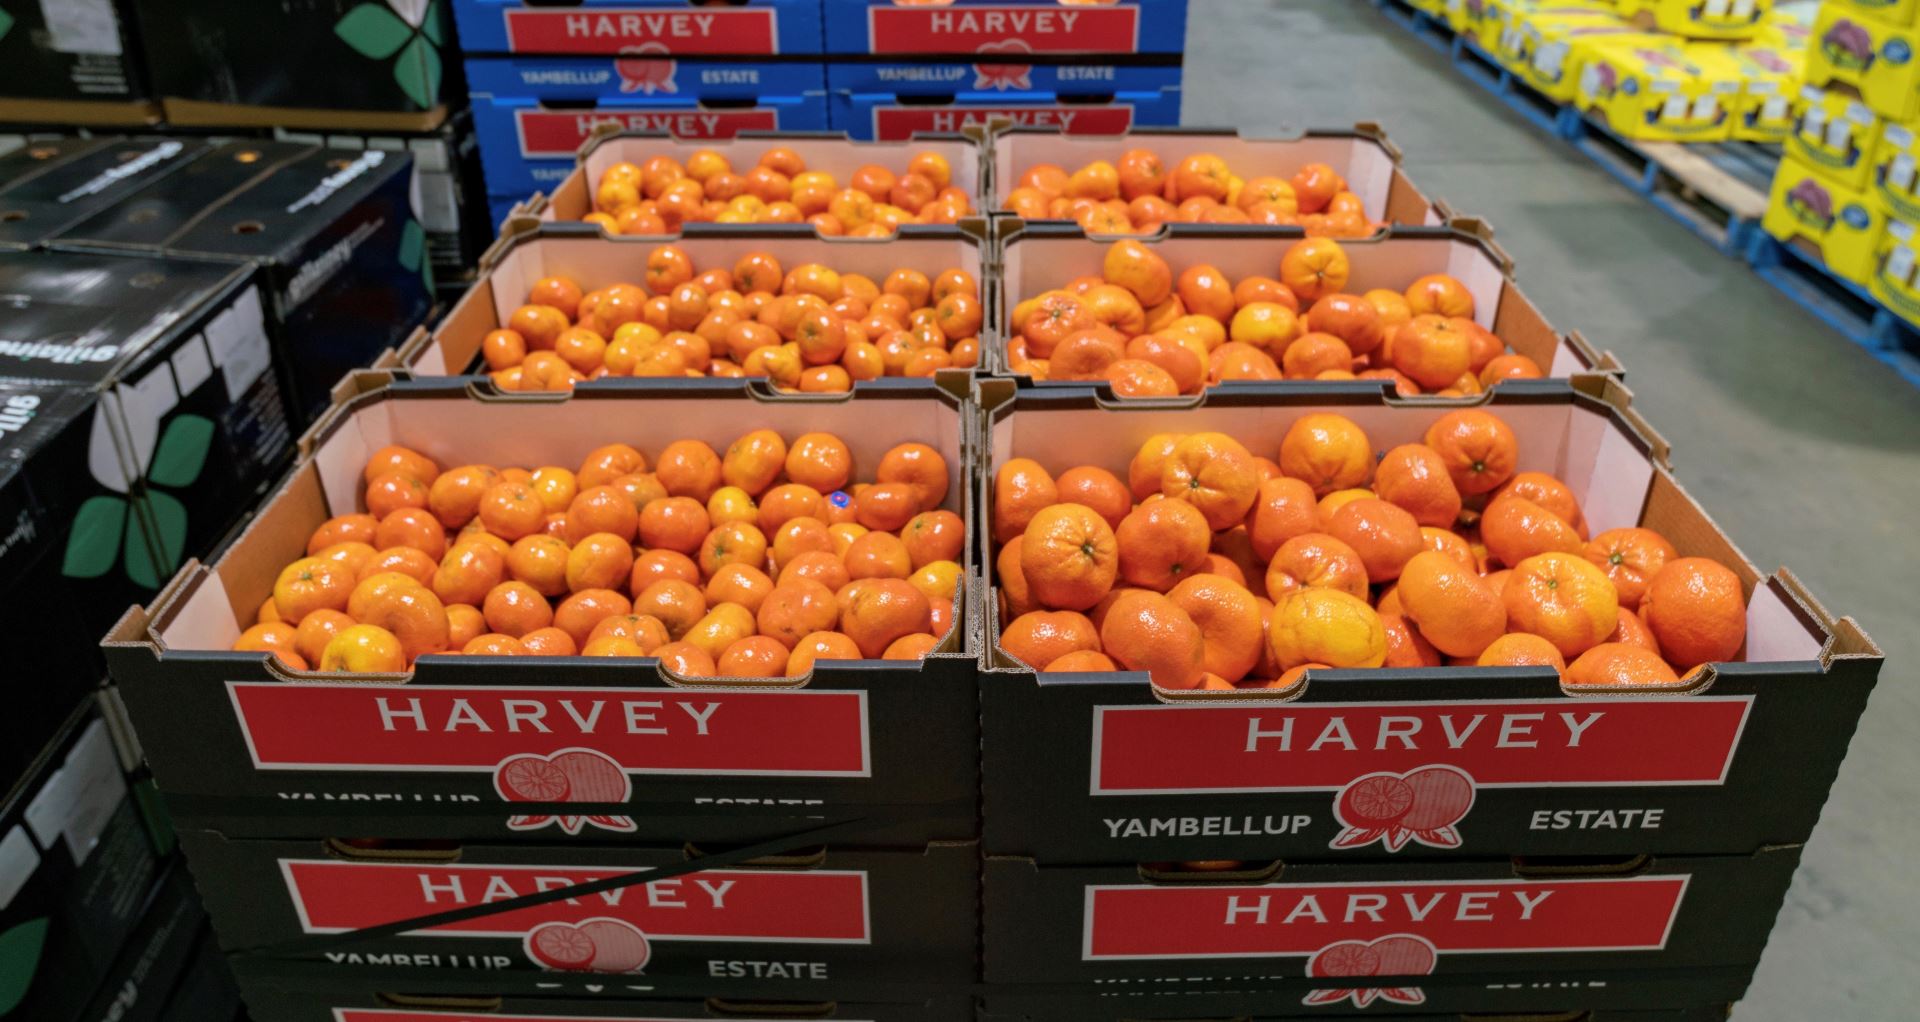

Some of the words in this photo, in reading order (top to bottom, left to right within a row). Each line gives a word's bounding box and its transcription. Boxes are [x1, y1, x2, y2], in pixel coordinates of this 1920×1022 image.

[565, 15, 715, 37] HARVEY
[930, 11, 1079, 34] HARVEY
[520, 71, 611, 85] YAMBELLUP
[701, 70, 760, 85] ESTATE
[876, 67, 966, 81] YAMBELLUP
[1056, 66, 1115, 82] ESTATE
[374, 697, 723, 736] HARVEY
[1243, 712, 1606, 753] HARVEY
[1102, 814, 1313, 839] YAMBELLUP
[1528, 808, 1665, 831] ESTATE
[1223, 890, 1555, 926] HARVEY
[707, 959, 829, 979] ESTATE
